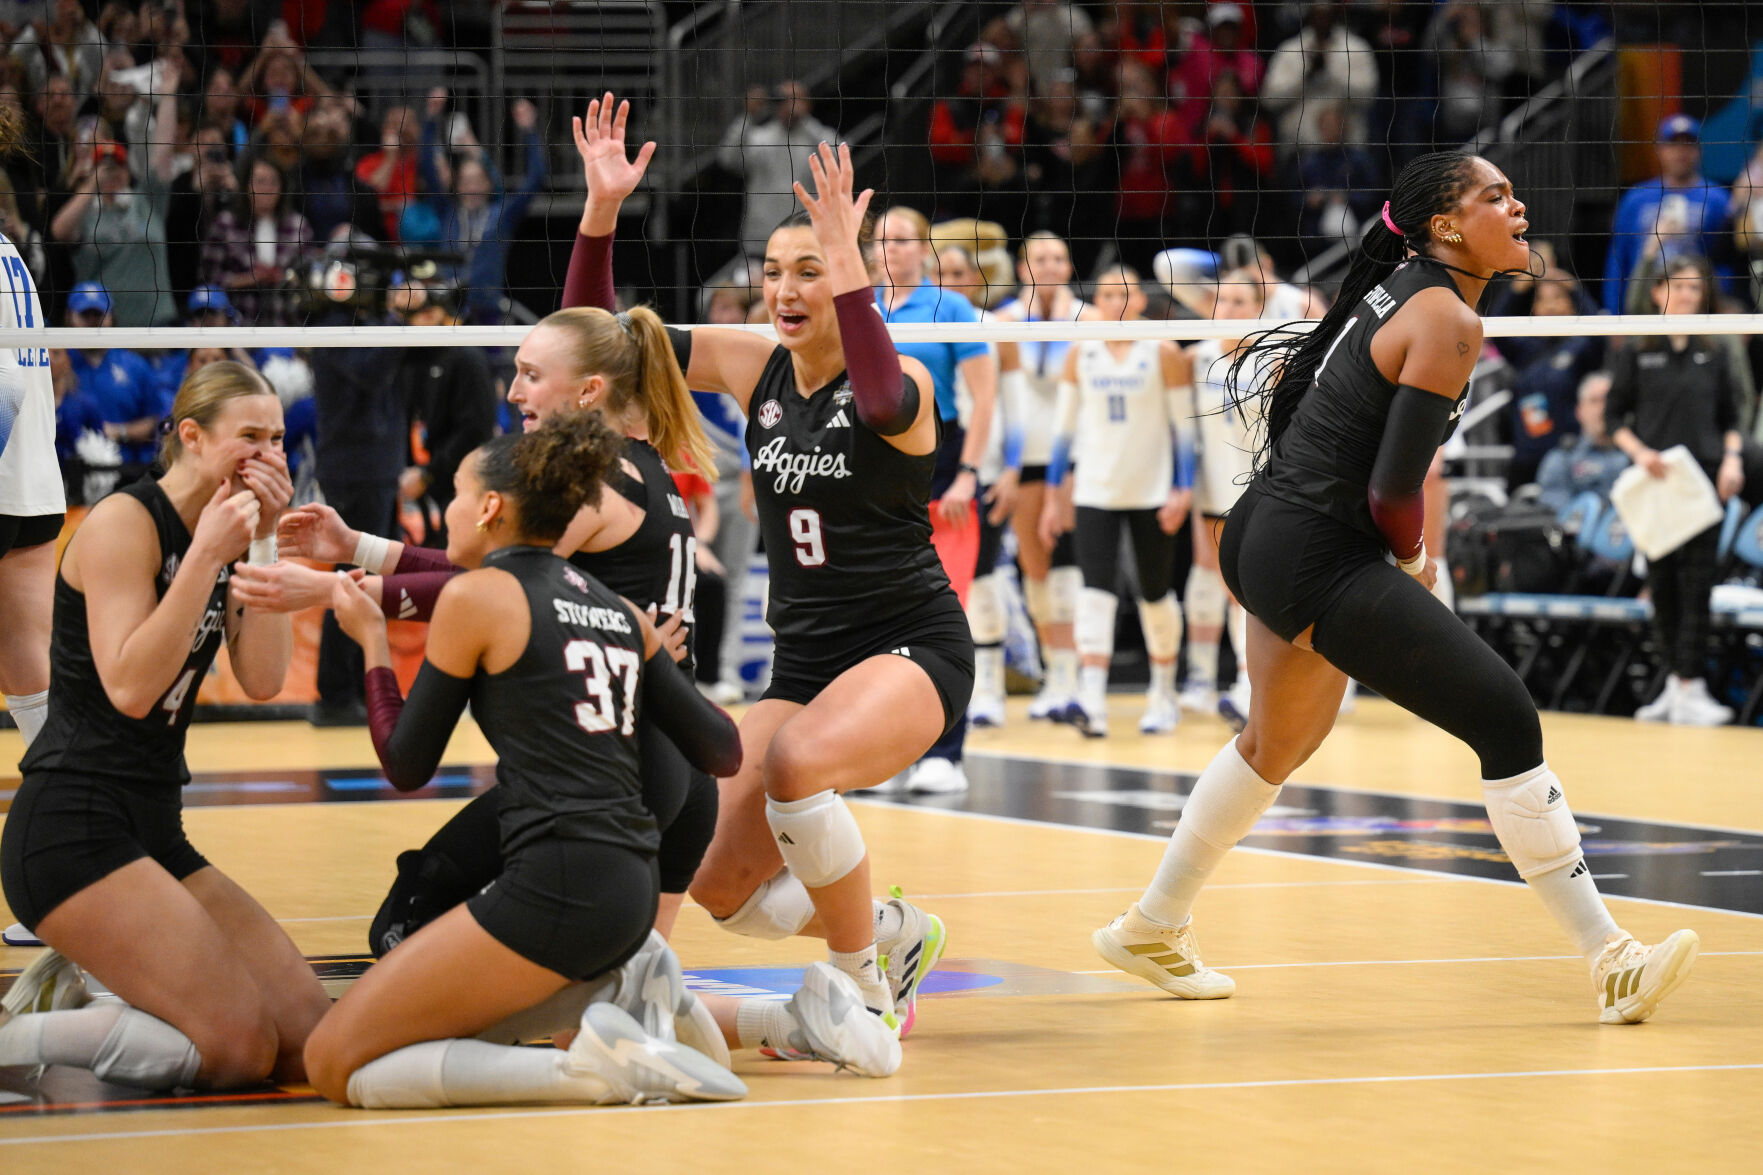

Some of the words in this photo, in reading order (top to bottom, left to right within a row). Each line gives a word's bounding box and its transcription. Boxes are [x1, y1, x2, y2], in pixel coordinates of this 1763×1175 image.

[1, 256, 34, 328] 17
[753, 436, 853, 494] Aggies
[788, 506, 828, 568] 9
[161, 668, 200, 726] 4
[563, 637, 640, 738] 37
